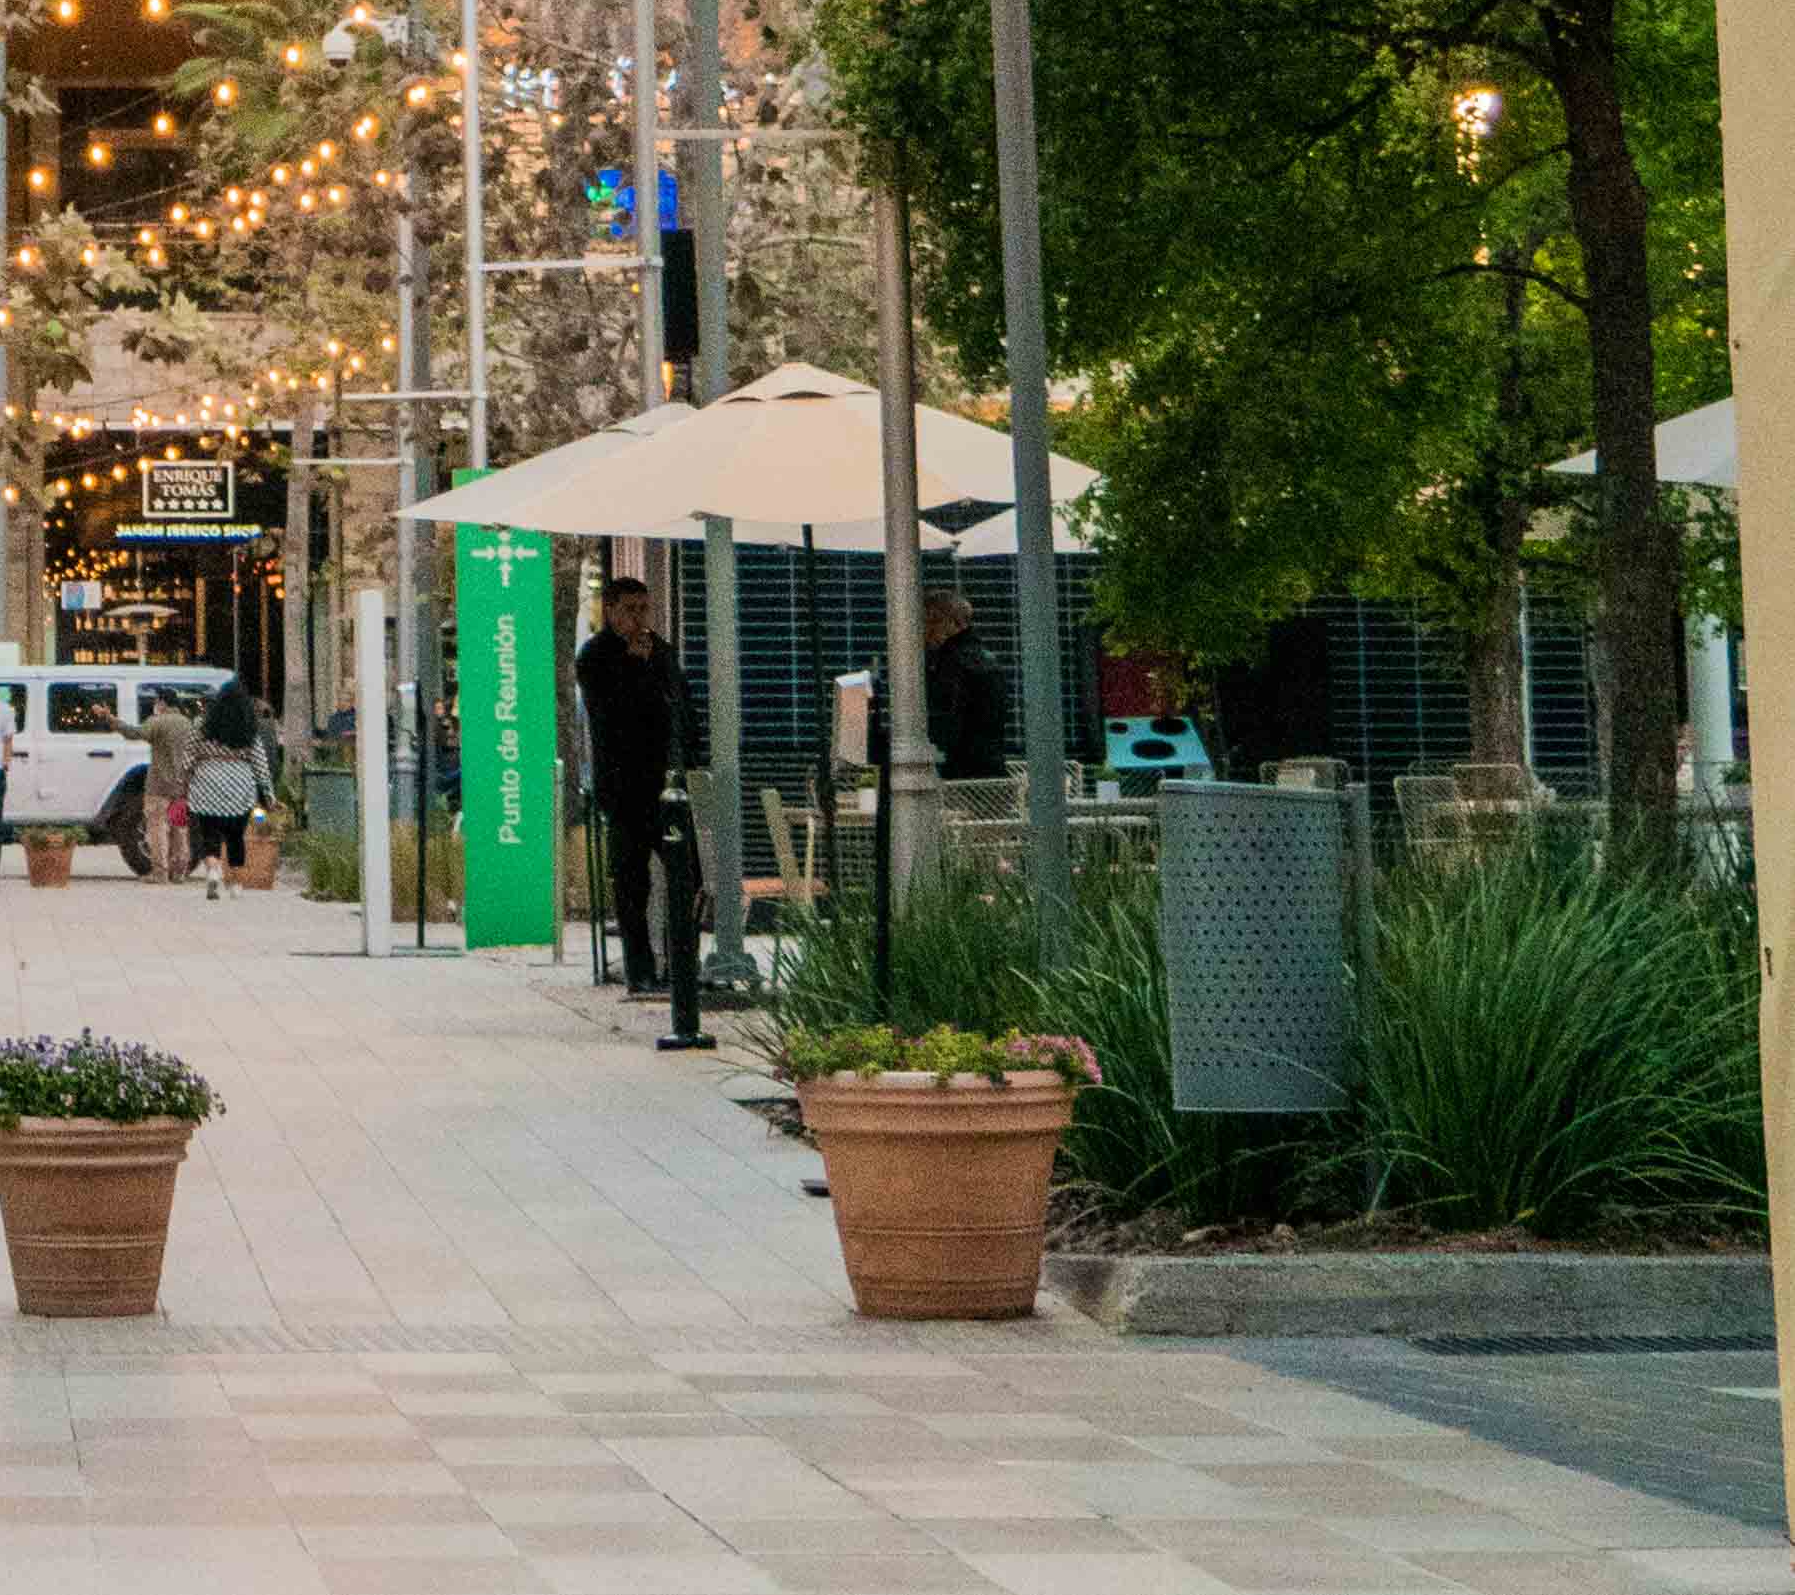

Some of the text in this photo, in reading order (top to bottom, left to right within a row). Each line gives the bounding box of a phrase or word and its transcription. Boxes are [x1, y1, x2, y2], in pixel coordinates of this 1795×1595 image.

[152, 469, 222, 484] ENRIQUE
[493, 613, 521, 845] Punto de Reunión
